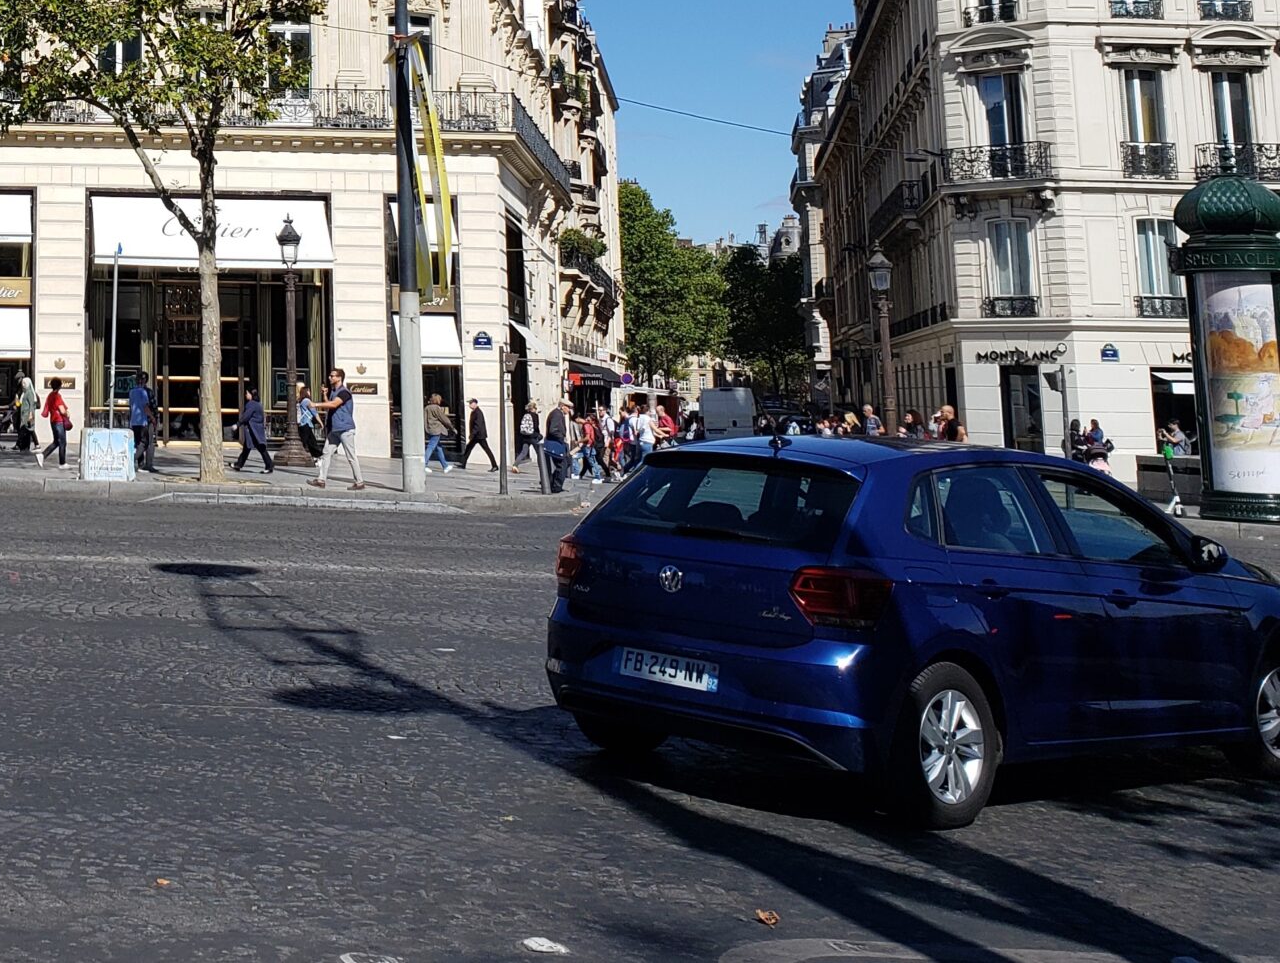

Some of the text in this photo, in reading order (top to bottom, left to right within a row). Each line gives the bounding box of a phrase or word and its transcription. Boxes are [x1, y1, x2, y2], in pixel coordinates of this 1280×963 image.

[162, 216, 259, 238] Cier
[1185, 252, 1276, 266] SPECTACLE
[349, 384, 376, 393] Cartier
[624, 650, 718, 690] FB-249-NW 92
